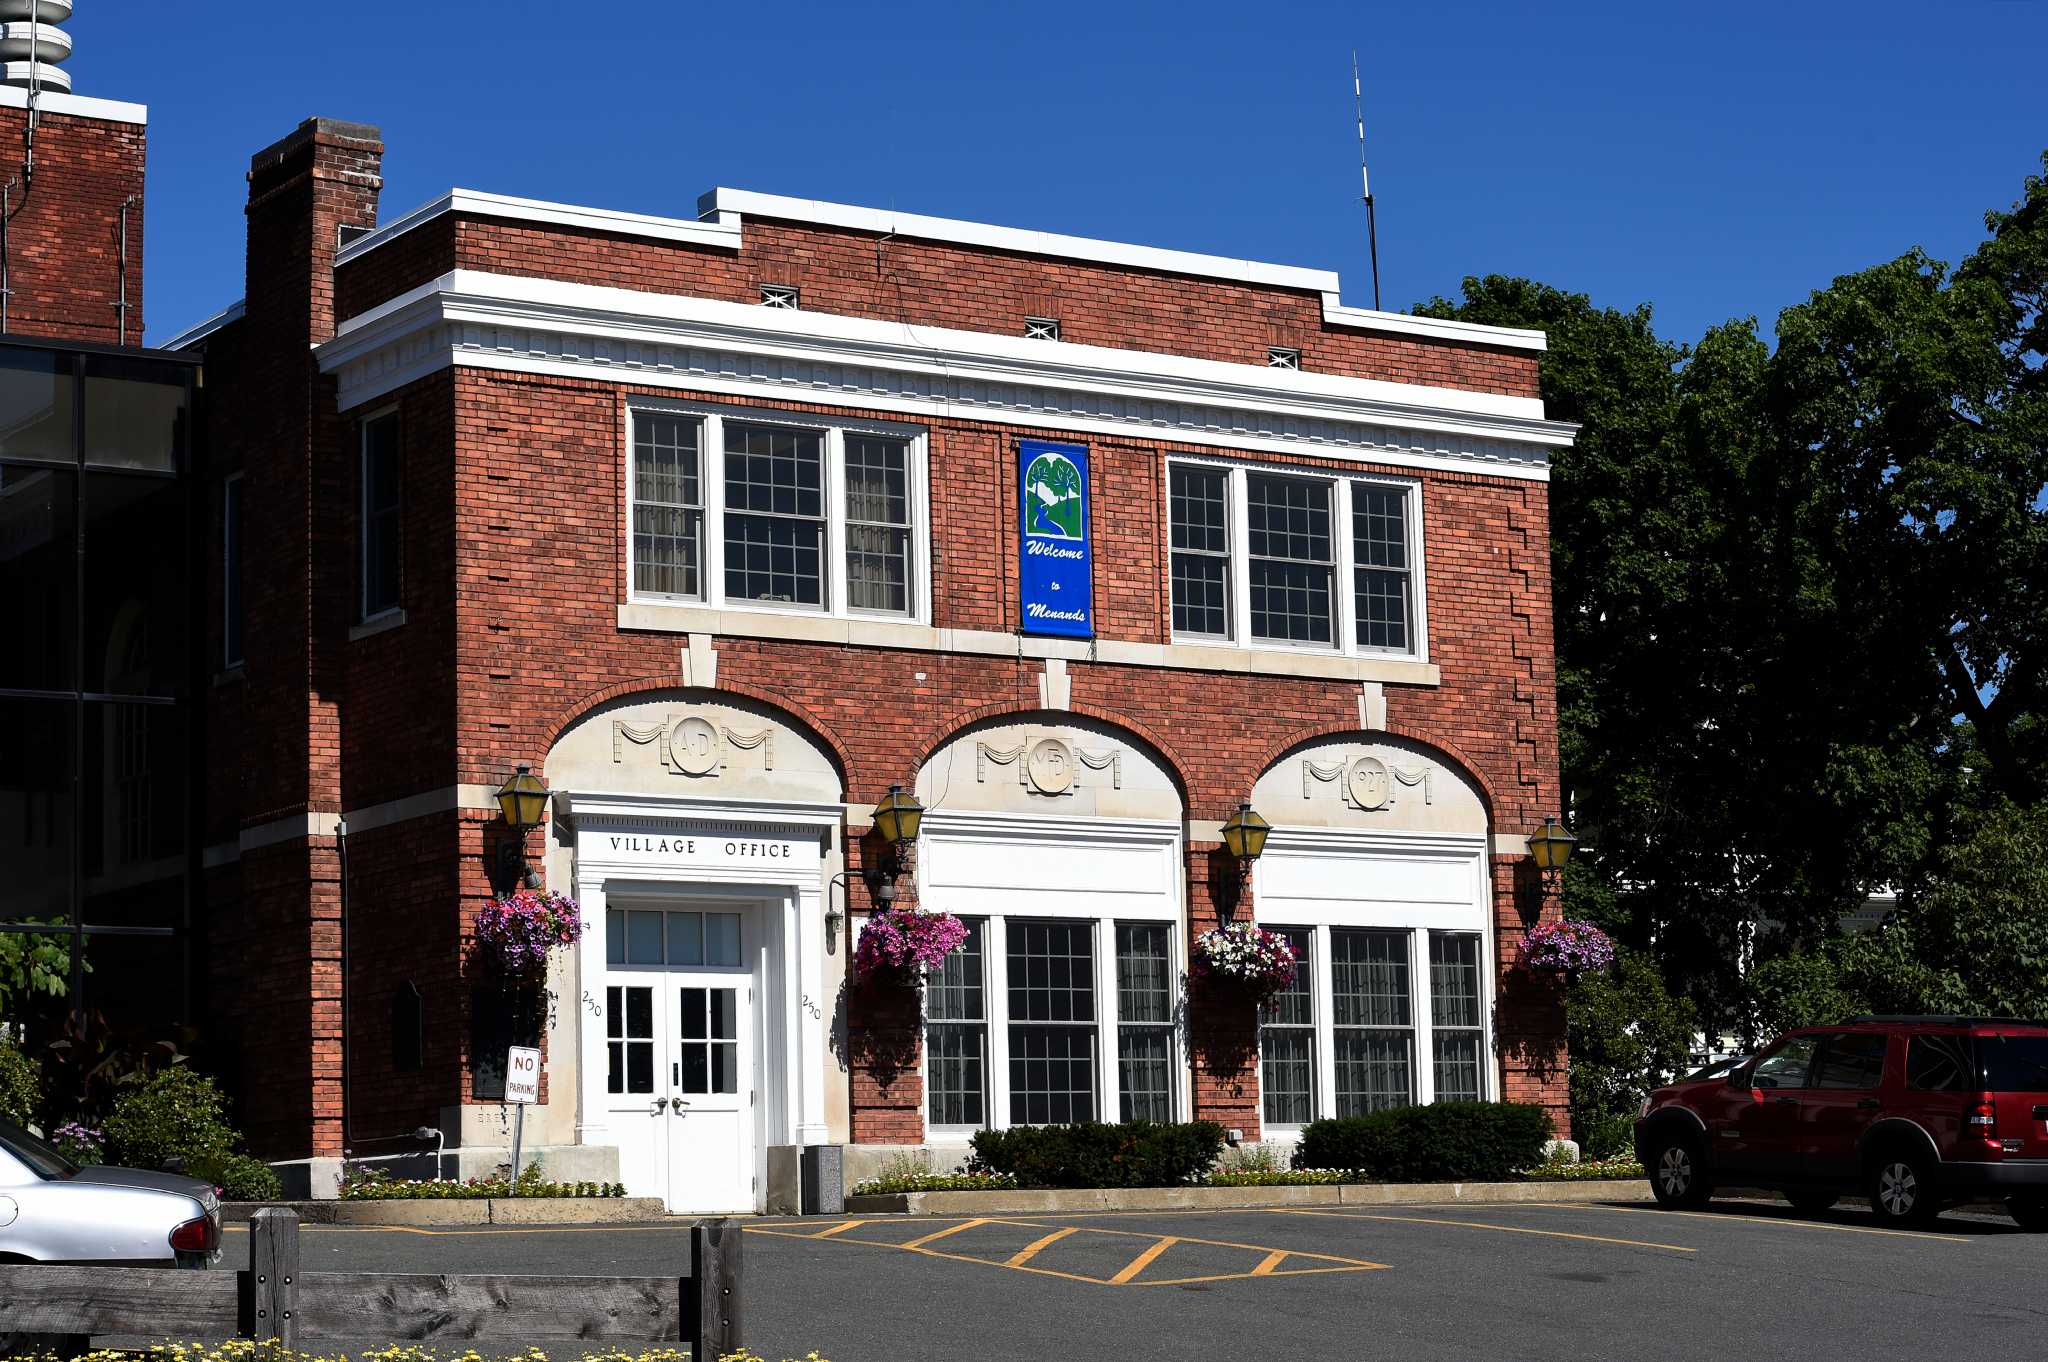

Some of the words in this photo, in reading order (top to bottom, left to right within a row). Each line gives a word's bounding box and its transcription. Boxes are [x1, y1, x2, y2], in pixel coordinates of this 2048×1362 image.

[1026, 540, 1084, 560] Welcome
[1051, 581, 1061, 591] to
[1026, 602, 1086, 622] Menands
[610, 837, 696, 853] VILLAGE
[725, 842, 792, 858] OFFICE
[582, 990, 602, 1017] 250
[802, 994, 821, 1020] 250
[514, 1056, 534, 1072] NO
[509, 1082, 535, 1096] PARKING
